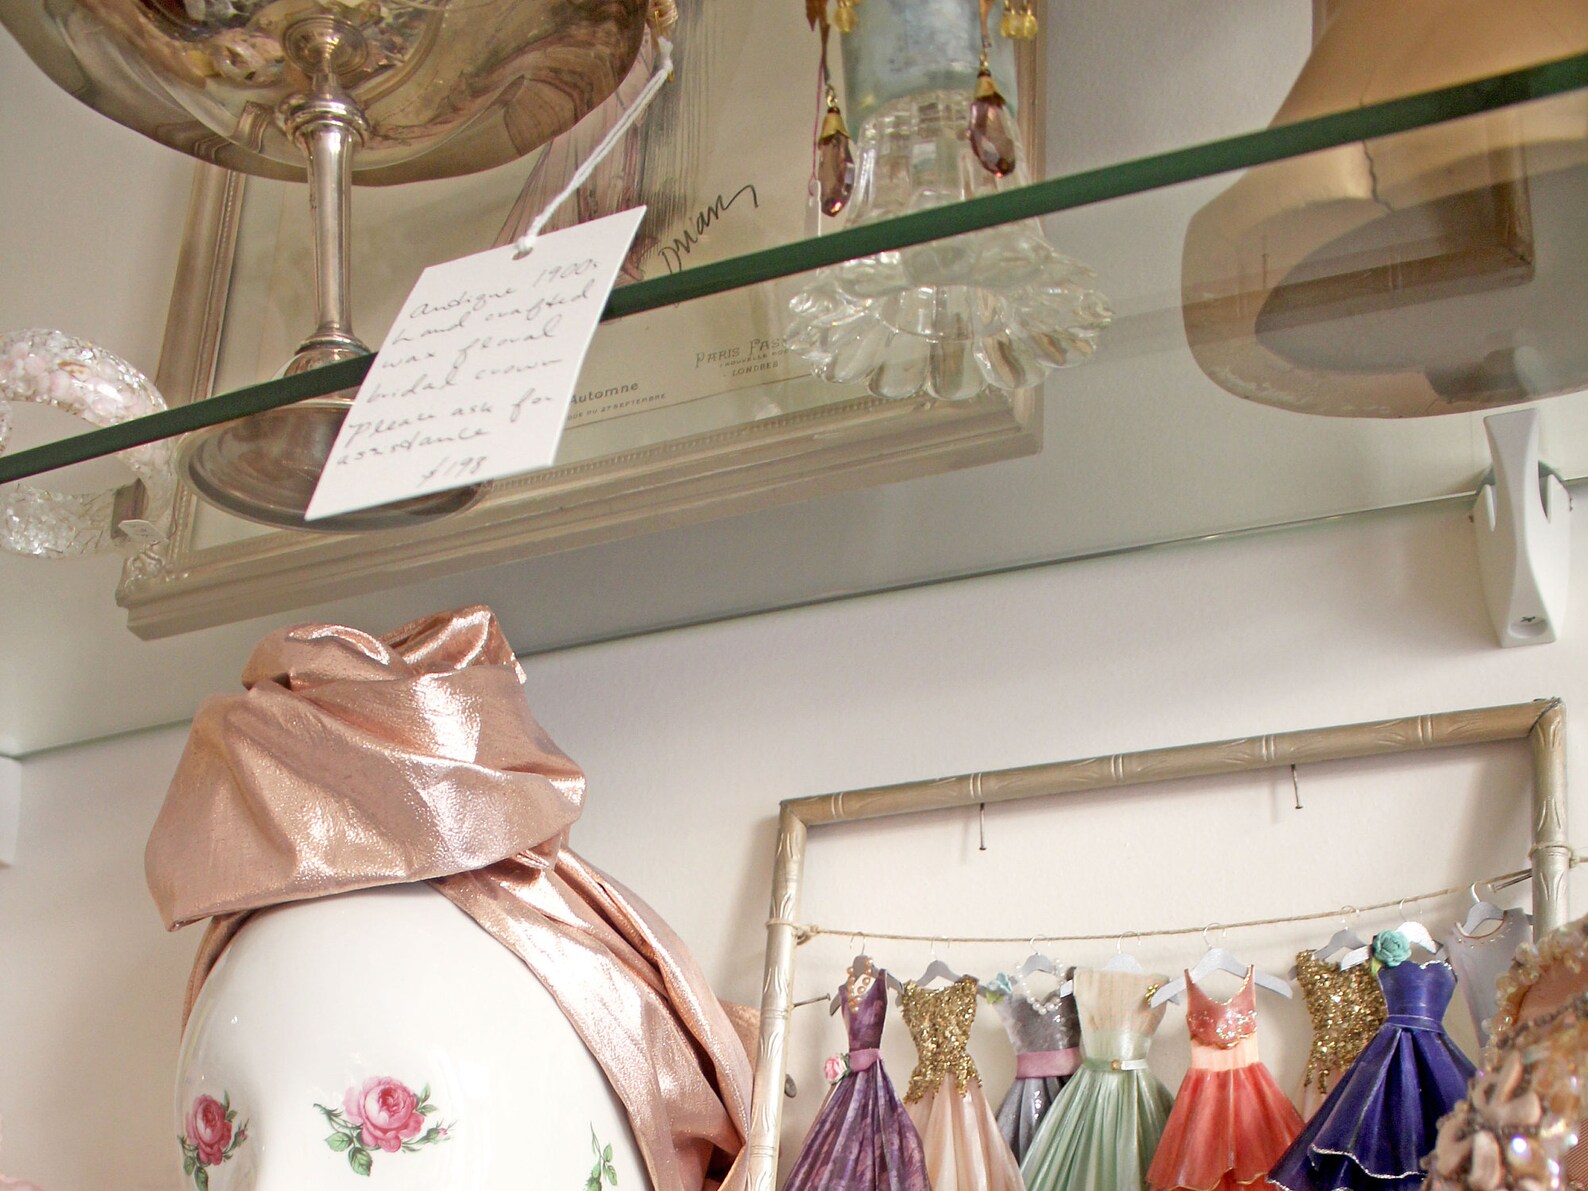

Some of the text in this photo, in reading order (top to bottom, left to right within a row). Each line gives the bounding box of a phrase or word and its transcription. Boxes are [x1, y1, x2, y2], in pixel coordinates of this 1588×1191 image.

[484, 280, 594, 322] crafted
[382, 315, 563, 370] wax floral
[695, 346, 741, 368] PARIS
[367, 358, 563, 404] bridal crown
[731, 360, 779, 377] LONDRES
[451, 401, 493, 415] ask
[510, 388, 554, 423] for
